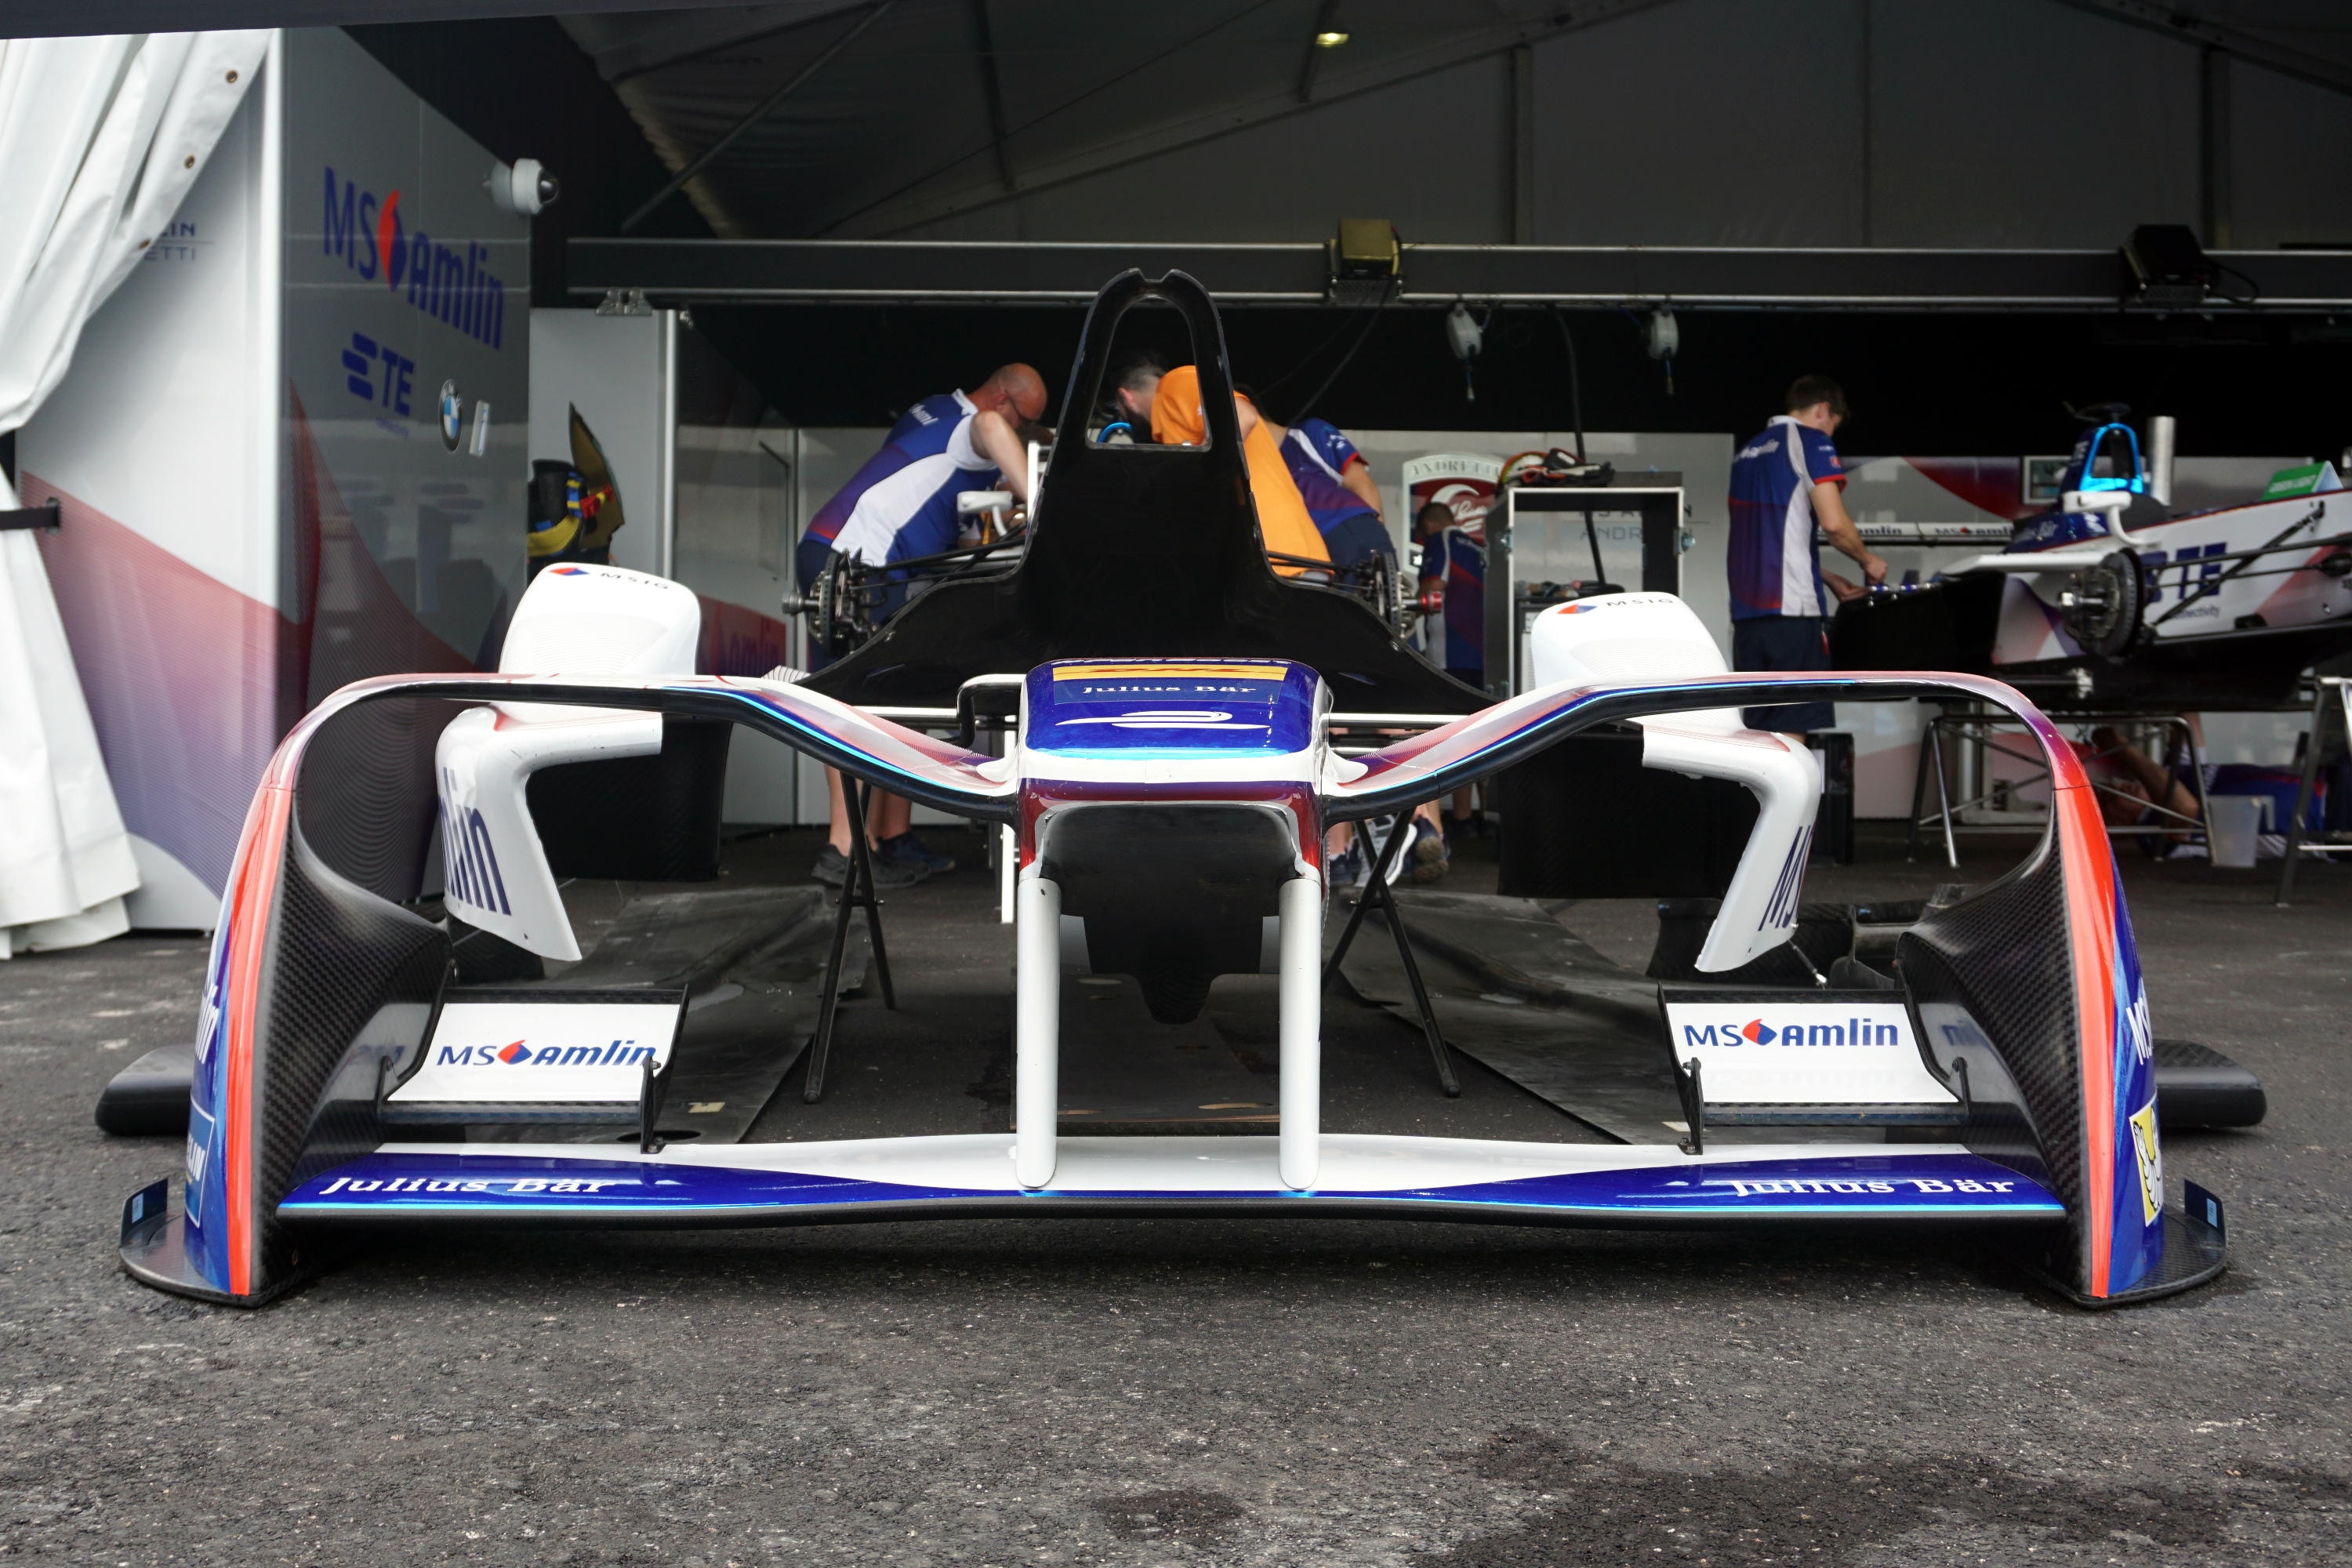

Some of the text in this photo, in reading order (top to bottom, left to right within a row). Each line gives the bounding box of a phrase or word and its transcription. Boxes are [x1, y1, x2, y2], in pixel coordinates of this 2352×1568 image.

[323, 166, 377, 281] MS
[601, 572, 669, 589] MSIG
[1683, 1024, 1743, 1047] MS
[436, 1045, 497, 1065] MS
[319, 1177, 615, 1194] Julius Bär
[1730, 1179, 2014, 1196] Julius Bär
